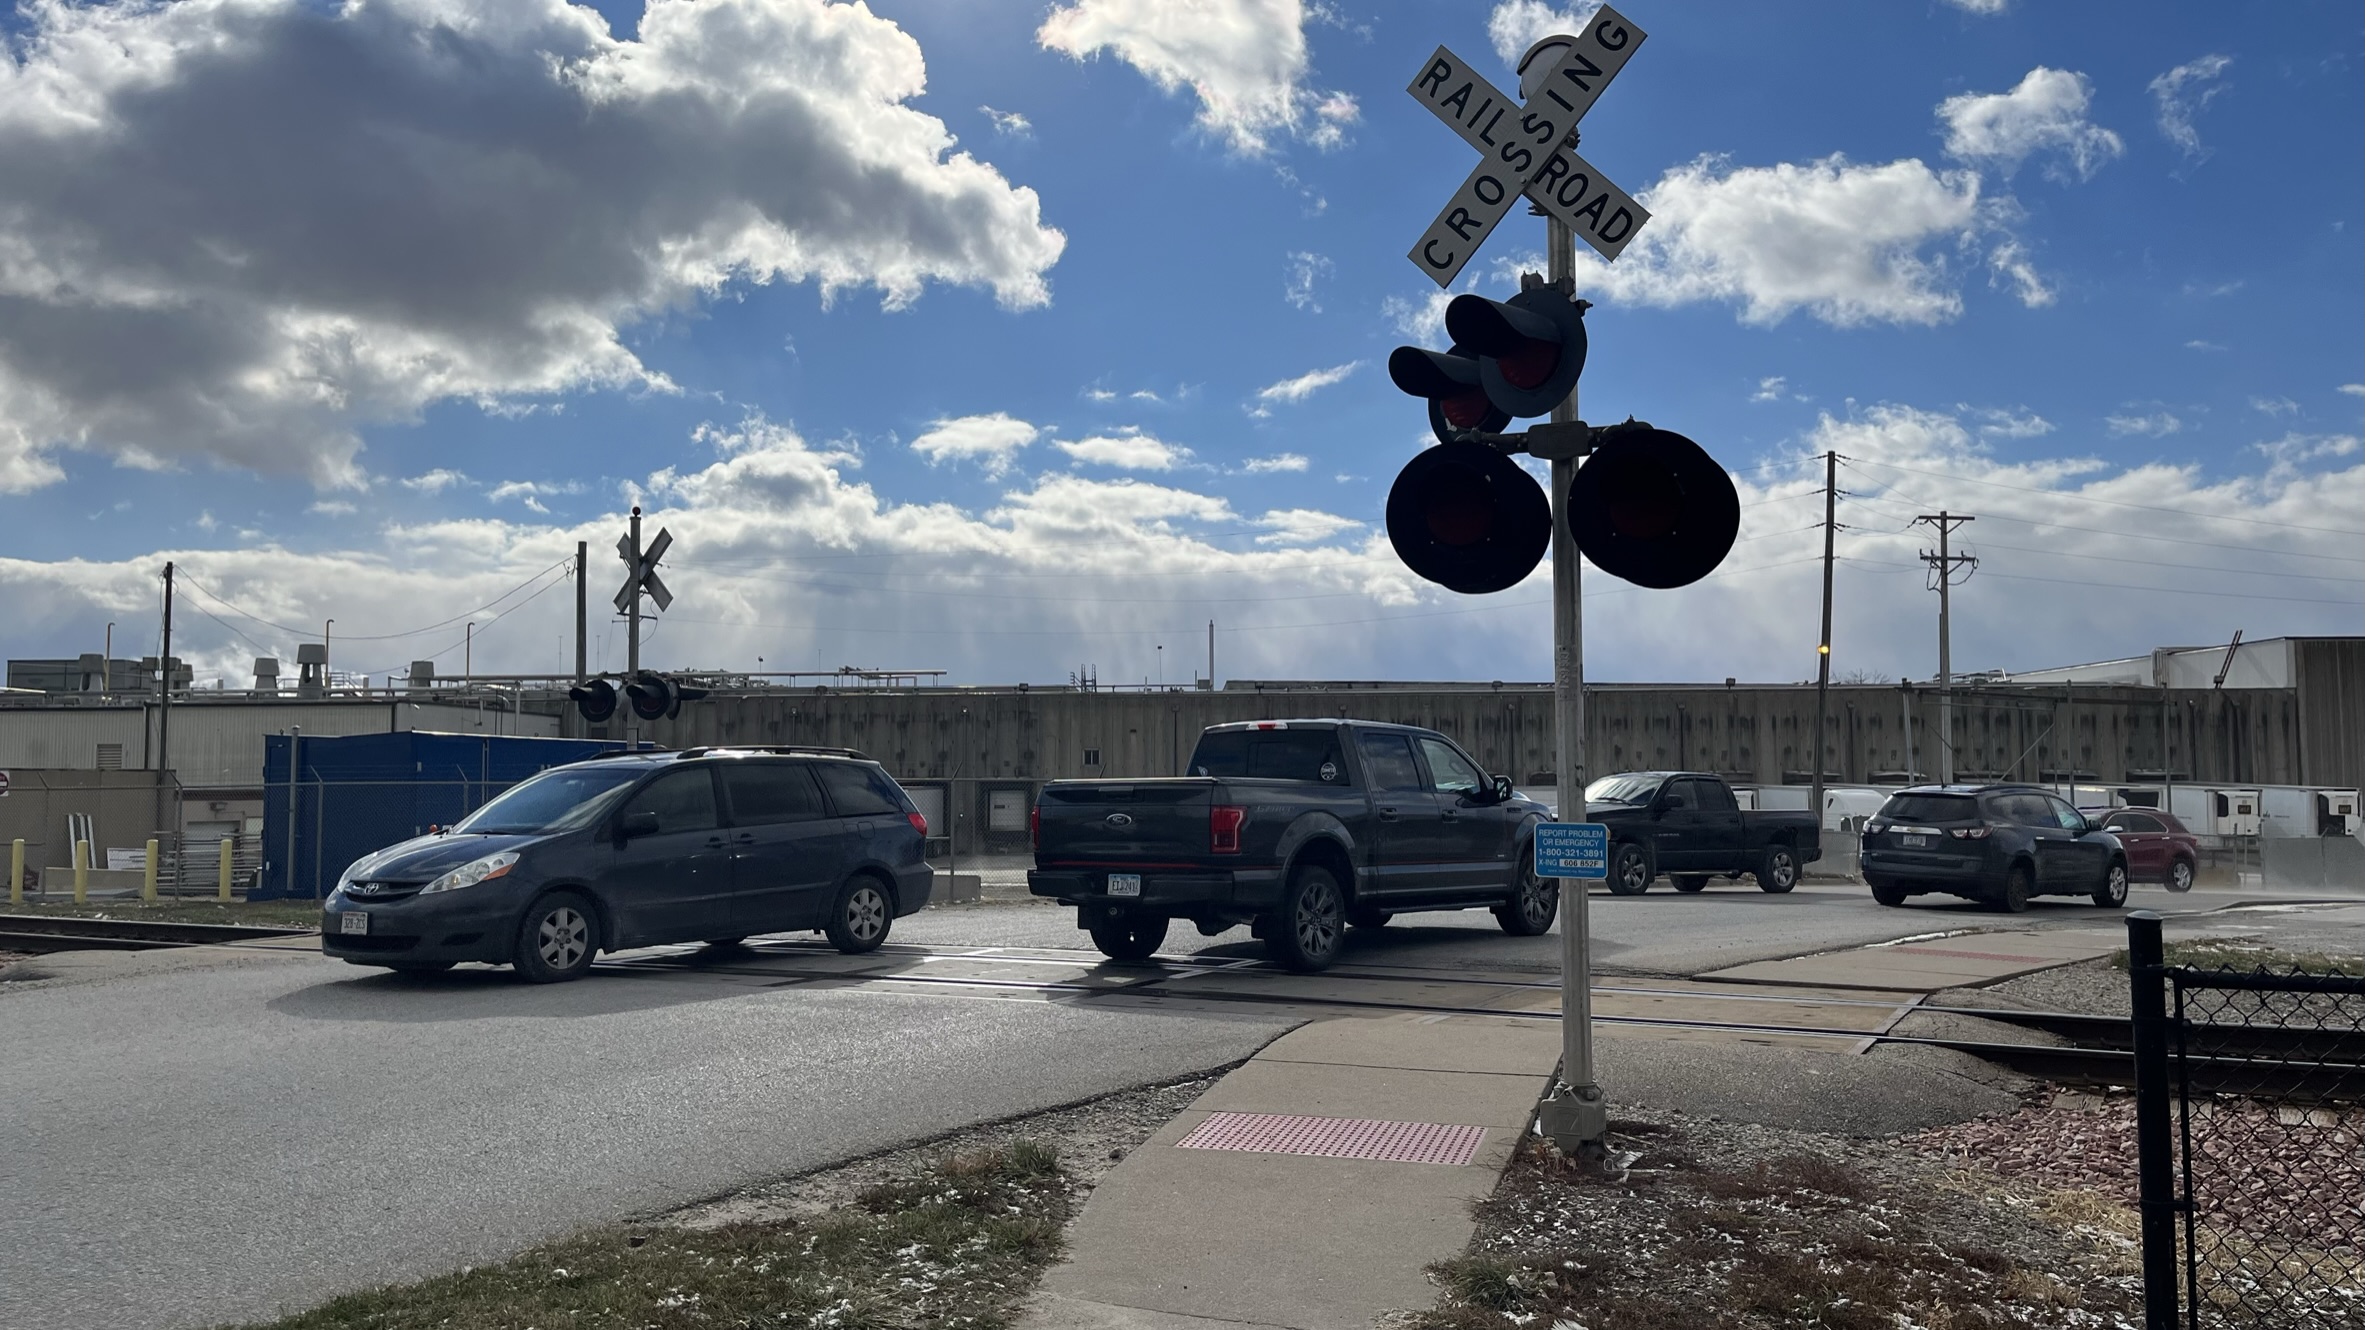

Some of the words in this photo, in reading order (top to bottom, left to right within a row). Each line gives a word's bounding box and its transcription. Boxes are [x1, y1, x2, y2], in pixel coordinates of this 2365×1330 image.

[1423, 20, 1629, 270] CROSSING
[1418, 57, 1505, 147] RAIL
[1533, 153, 1633, 244] ROAD
[1539, 829, 1567, 837] REPORT
[1568, 830, 1603, 838] PROBLEM
[1554, 839, 1599, 847] EMERGENCY
[1539, 849, 1603, 857] 1-800-321-3891
